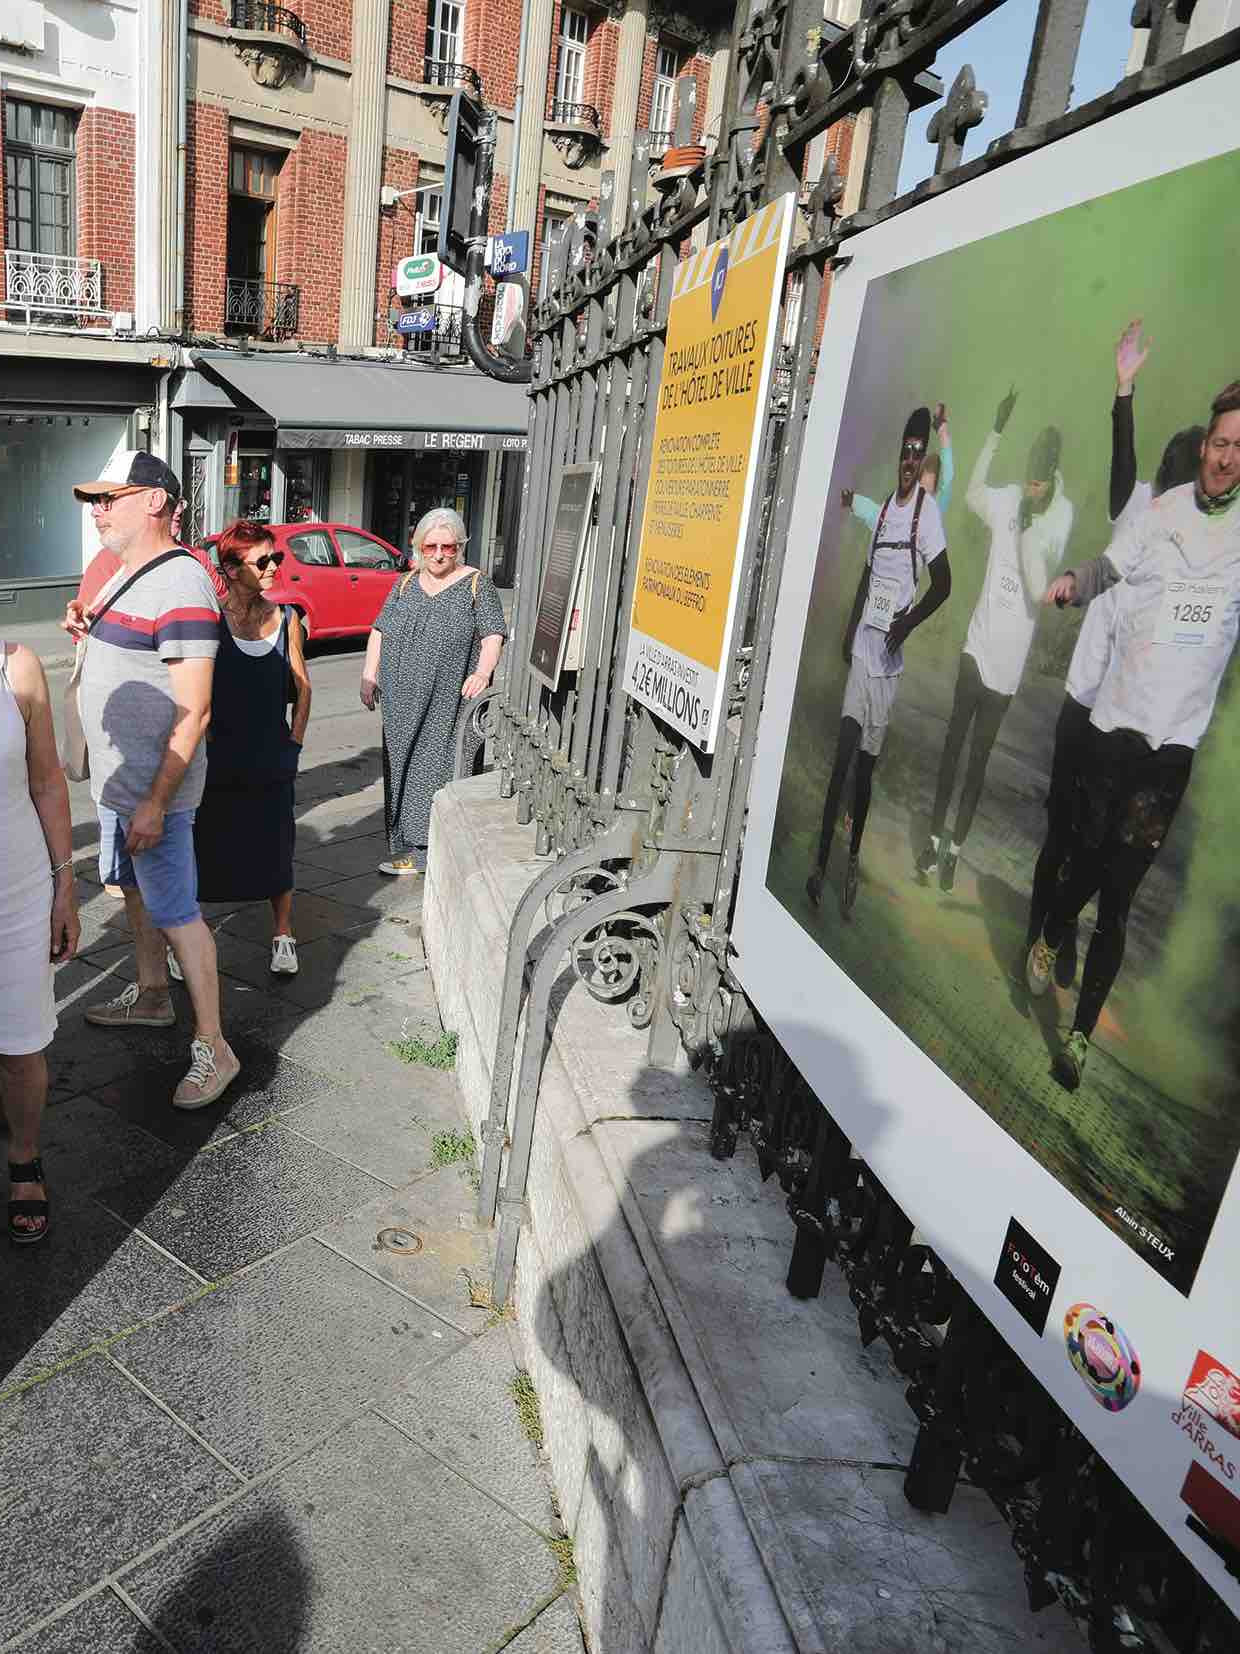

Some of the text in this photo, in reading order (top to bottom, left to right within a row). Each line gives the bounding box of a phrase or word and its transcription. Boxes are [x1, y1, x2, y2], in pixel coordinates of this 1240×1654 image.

[402, 315, 417, 325] FDJ
[668, 319, 758, 377] TRAVAUX TOITURES
[662, 360, 755, 410] DE L'HÔTEL DE VILLE
[344, 433, 403, 446] TABAC PRESSE
[424, 432, 438, 448] LE
[502, 437, 521, 448] LOTO
[1173, 603, 1213, 623] 1285
[631, 660, 701, 731] 4,2€ MILLIONS
[1114, 1205, 1175, 1262] Alain STEUX
[1012, 1268, 1037, 1300] festival
[1182, 1399, 1208, 1434] Ville
[1170, 1411, 1236, 1480] d'ARRAS
